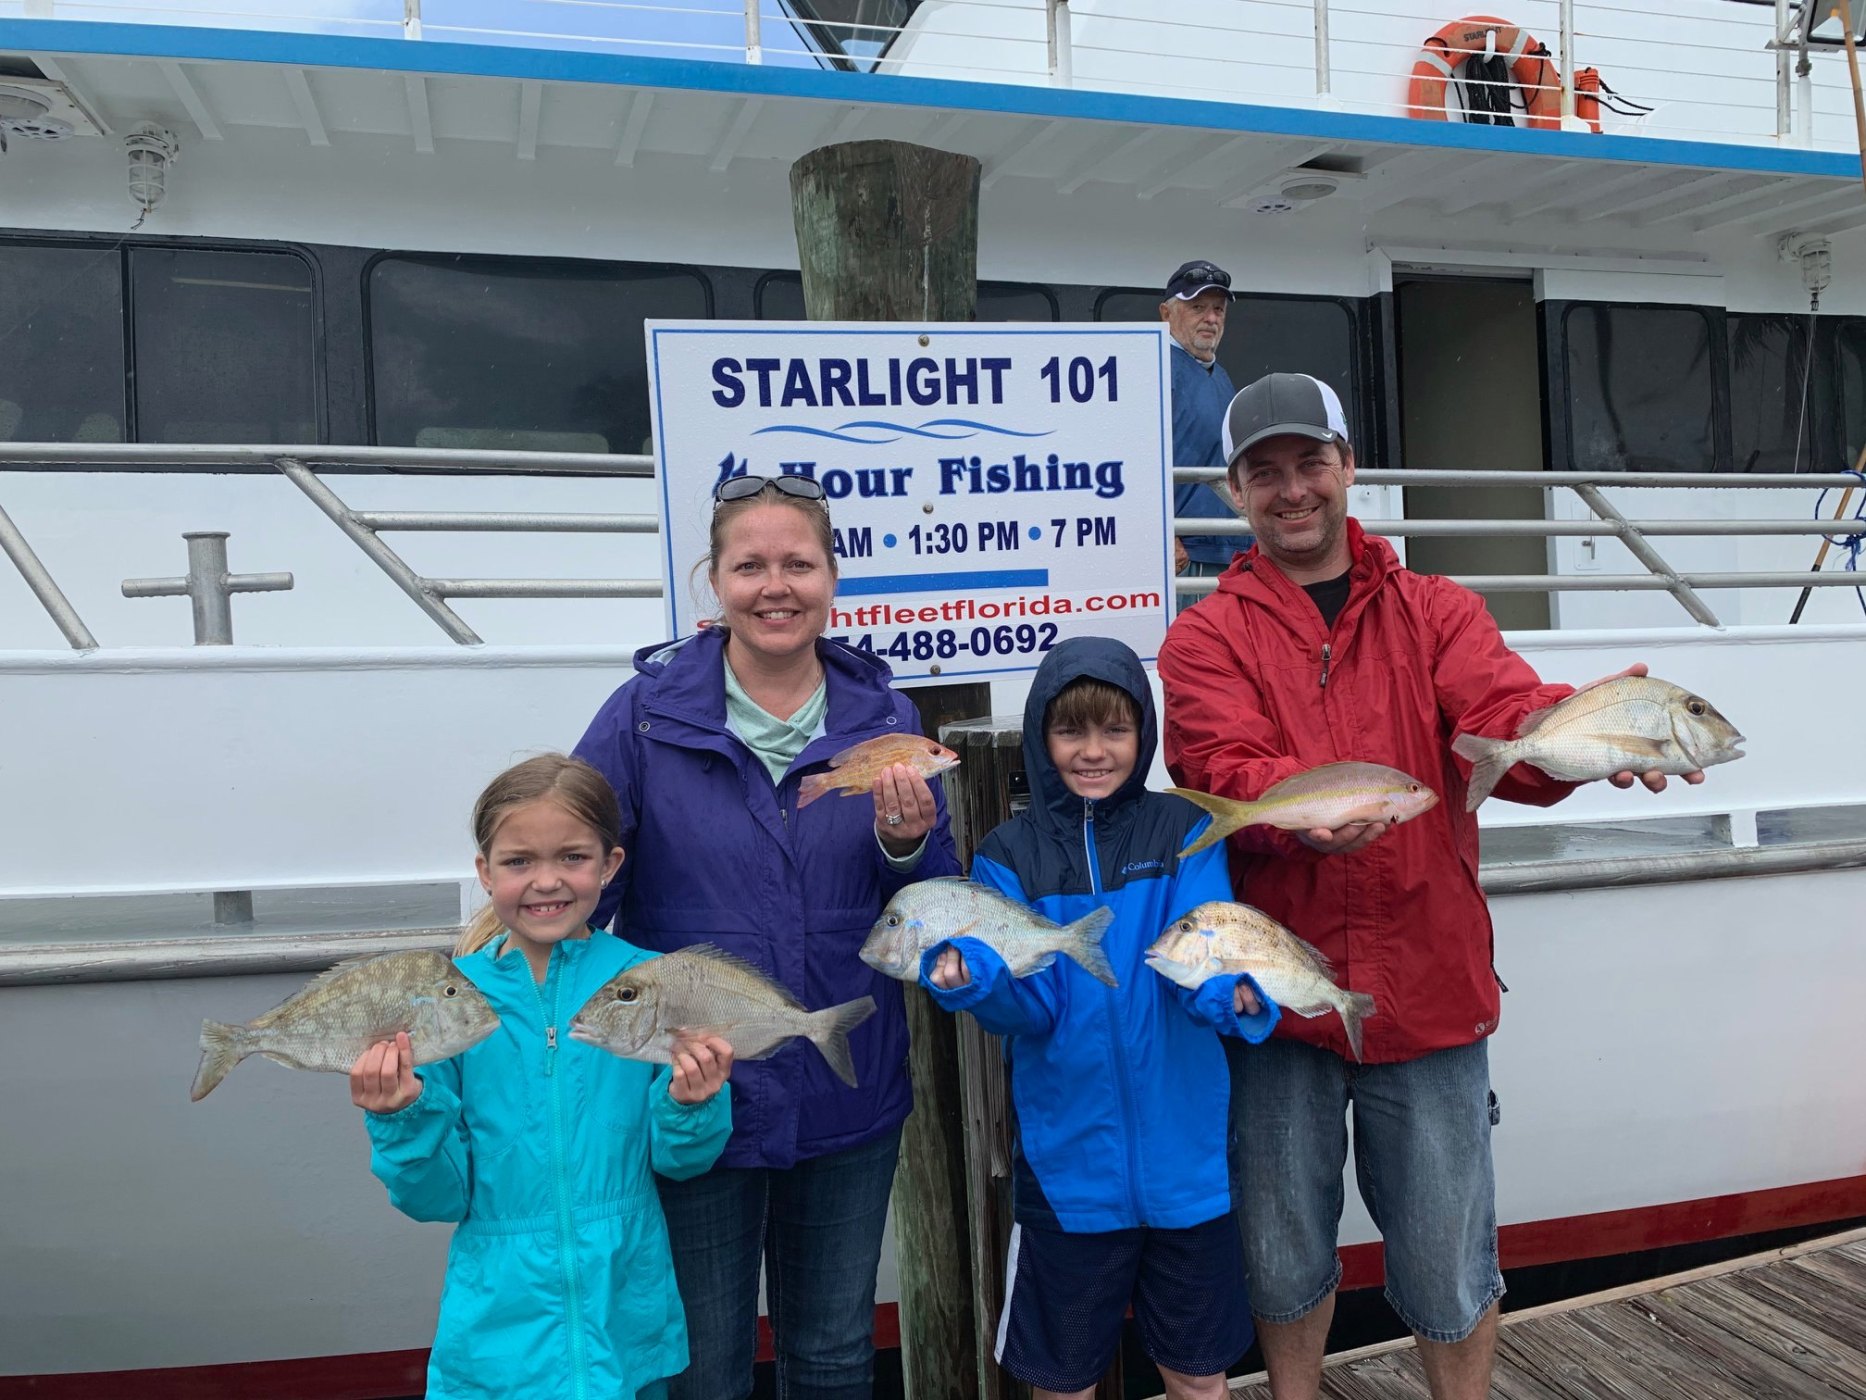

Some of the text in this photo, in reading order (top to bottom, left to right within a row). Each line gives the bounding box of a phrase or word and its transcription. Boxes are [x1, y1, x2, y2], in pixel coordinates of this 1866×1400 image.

[1463, 26, 1502, 42] STARLT
[711, 356, 1118, 408] STARLIGHT 101
[938, 453, 1125, 499] Fishing
[831, 516, 1117, 558] AM 1:30 PM 7 PM
[830, 622, 1059, 663] 4-488-0692
